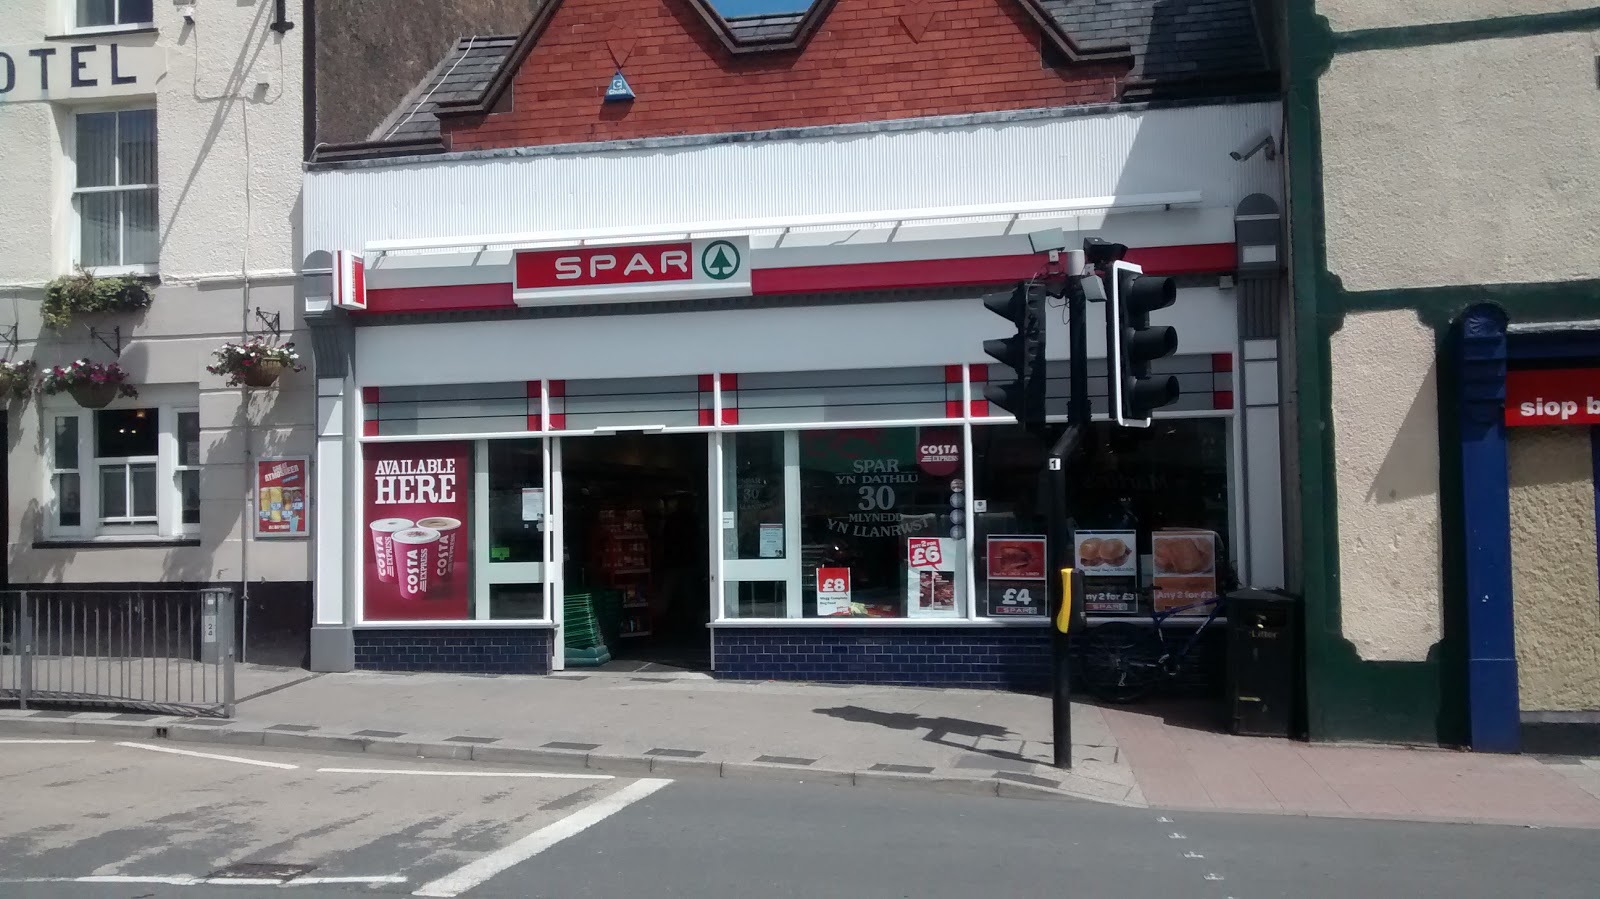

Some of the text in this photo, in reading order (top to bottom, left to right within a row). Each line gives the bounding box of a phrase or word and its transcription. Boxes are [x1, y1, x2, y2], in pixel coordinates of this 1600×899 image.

[555, 251, 687, 280] SPAR
[1520, 397, 1578, 420] siop
[921, 445, 958, 455] COSTA
[375, 458, 456, 475] AVAILABLE
[853, 459, 899, 473] SPAR
[1051, 459, 1057, 469] 1
[836, 474, 918, 485] YN DATHLU
[375, 475, 456, 504] HERE
[858, 485, 896, 511] 30
[849, 513, 904, 523] MLYNEDD
[828, 517, 929, 537] YN LLANRWST
[375, 536, 387, 577] COSTA
[420, 548, 428, 580] EXPRESS
[437, 535, 449, 576] COSTA
[912, 546, 940, 565] £6
[406, 549, 418, 594] COSTA
[823, 578, 845, 592] £8
[1002, 588, 1032, 605] £4
[1086, 593, 1097, 602] ny
[1106, 592, 1120, 600] for
[1122, 592, 1134, 600] £3
[1157, 591, 1213, 600] Any 2 for £2
[1251, 629, 1279, 638] Litter
